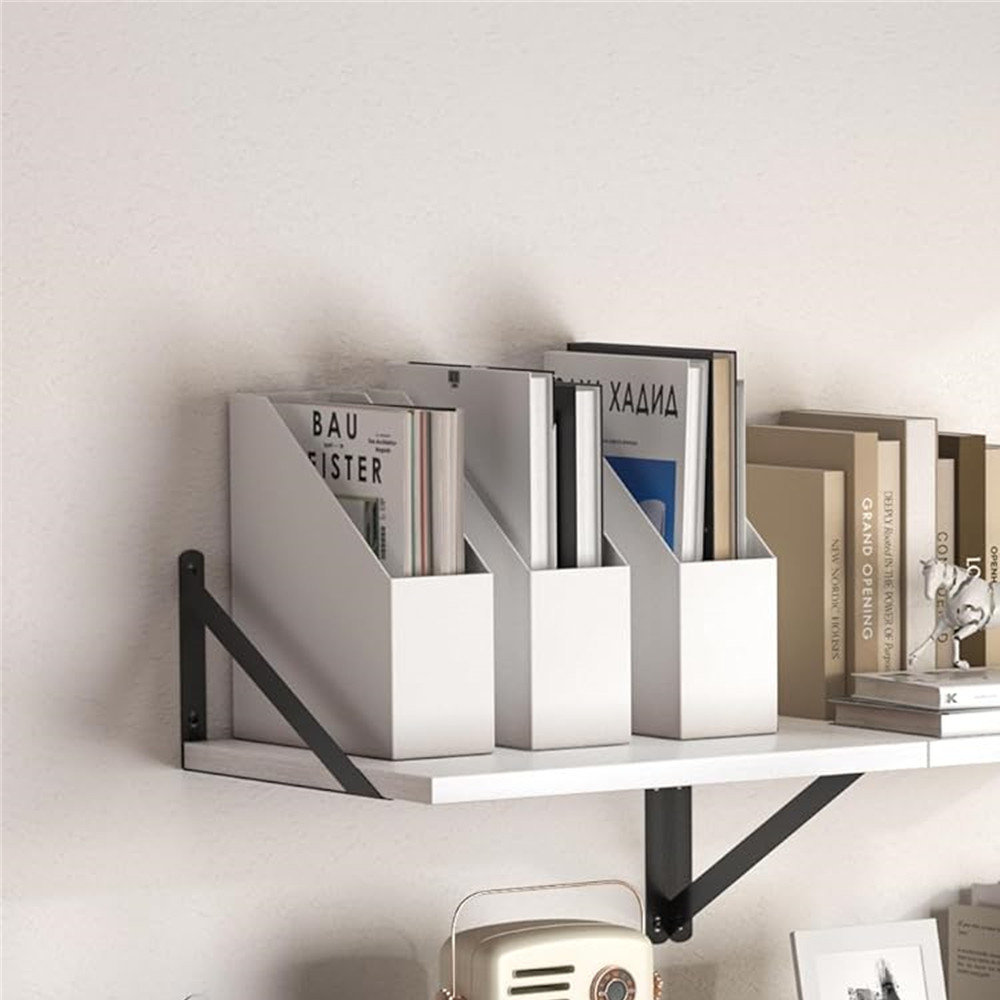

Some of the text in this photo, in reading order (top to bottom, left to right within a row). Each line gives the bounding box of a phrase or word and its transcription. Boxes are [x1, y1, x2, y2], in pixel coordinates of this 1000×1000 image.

[609, 380, 679, 418] ХАДИД
[312, 410, 358, 440] BAU
[861, 496, 873, 640] GRAND OPENING
